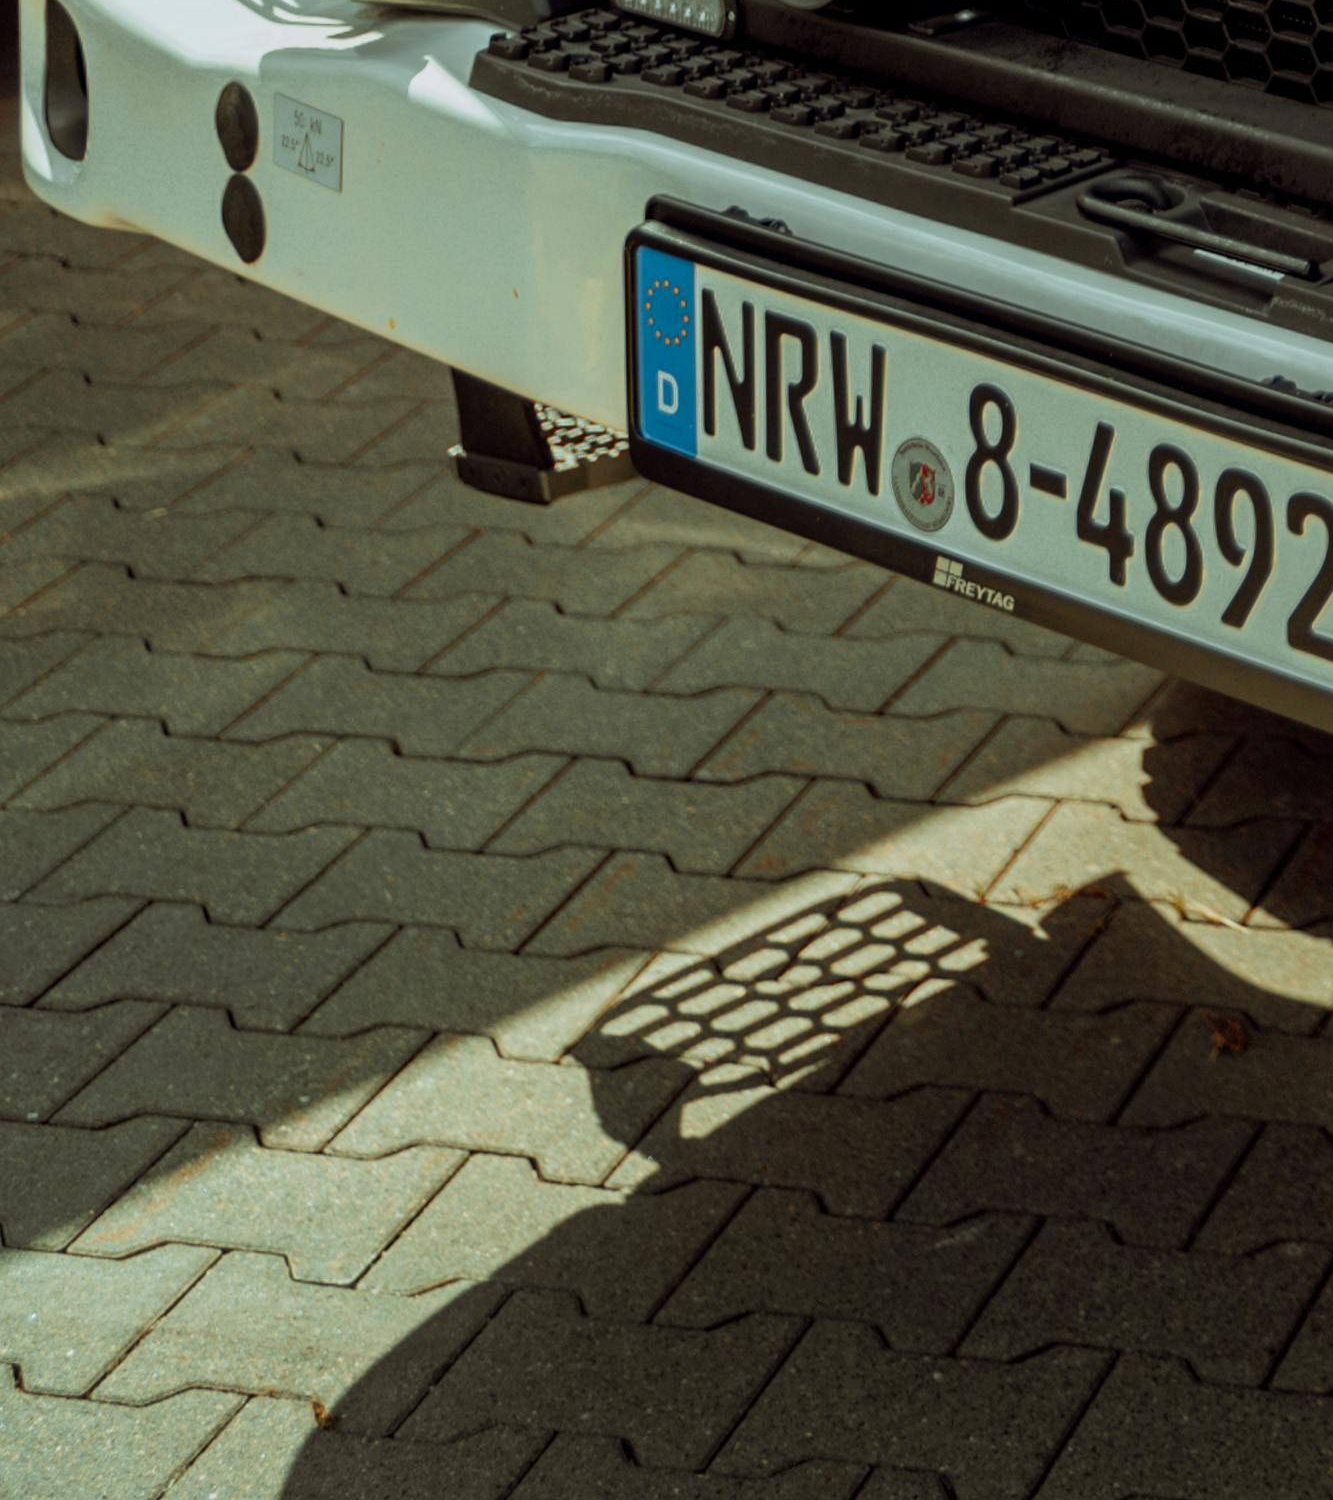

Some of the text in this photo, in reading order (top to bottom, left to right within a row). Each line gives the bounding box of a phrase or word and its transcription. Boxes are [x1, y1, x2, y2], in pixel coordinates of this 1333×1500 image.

[655, 368, 680, 417] D
[701, 286, 888, 497] NRW
[946, 574, 1015, 612] FREYTAG
